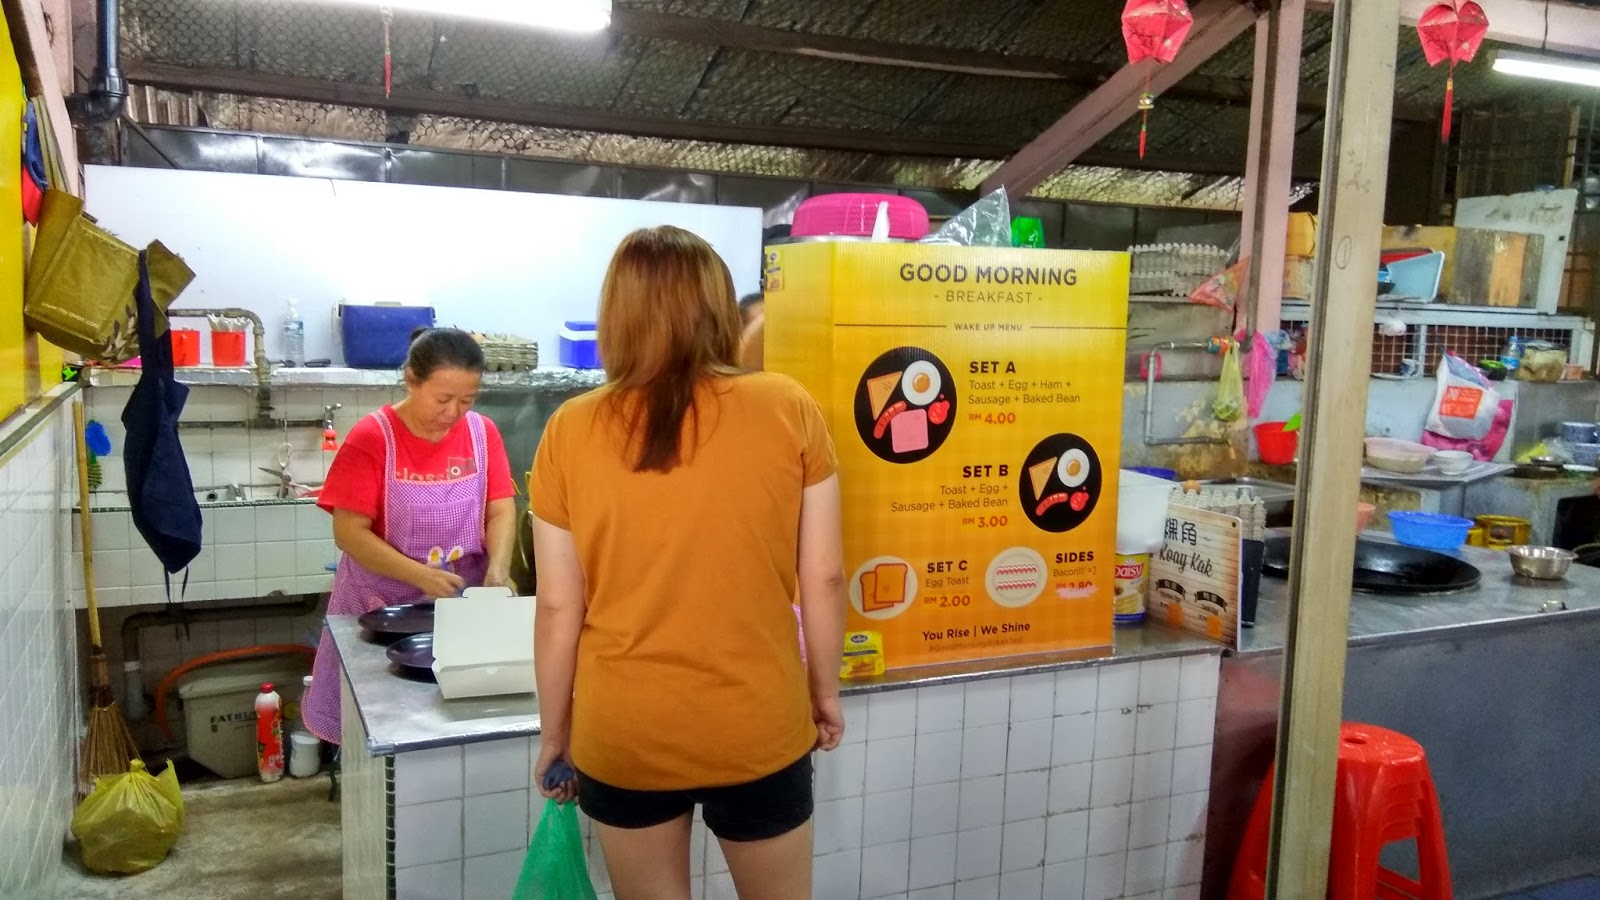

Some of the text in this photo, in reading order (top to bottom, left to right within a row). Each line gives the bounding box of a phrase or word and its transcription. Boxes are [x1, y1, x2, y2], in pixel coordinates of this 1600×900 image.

[899, 263, 1077, 286] GOOD MORNING
[946, 290, 1033, 303] BREAKFAST
[954, 323, 981, 331] WAKE
[969, 361, 1017, 374] SET A
[969, 380, 996, 390] Toast
[1008, 380, 1028, 391] Egg
[1040, 380, 1063, 389] Ham
[968, 394, 1011, 406] Sausage
[1023, 394, 1054, 403] Baked
[1056, 393, 1081, 403] Bean
[968, 412, 1016, 424] RM 4.00
[962, 464, 1009, 478] SET B
[940, 485, 967, 495] Toast
[979, 483, 999, 494] Egg
[891, 502, 936, 513] Sausage
[948, 498, 980, 509] Baked
[983, 497, 1008, 507] Bean
[962, 515, 1008, 528] RM 3.00
[1055, 550, 1094, 564] SIDES
[1159, 544, 1213, 578] Koay Kak
[927, 559, 968, 573] SET C
[925, 576, 969, 588] Egg Toast
[924, 594, 971, 608] RM 2.00
[922, 630, 943, 641] You
[947, 627, 970, 639] Rise
[980, 624, 998, 635] We
[1001, 622, 1031, 633] Shine
